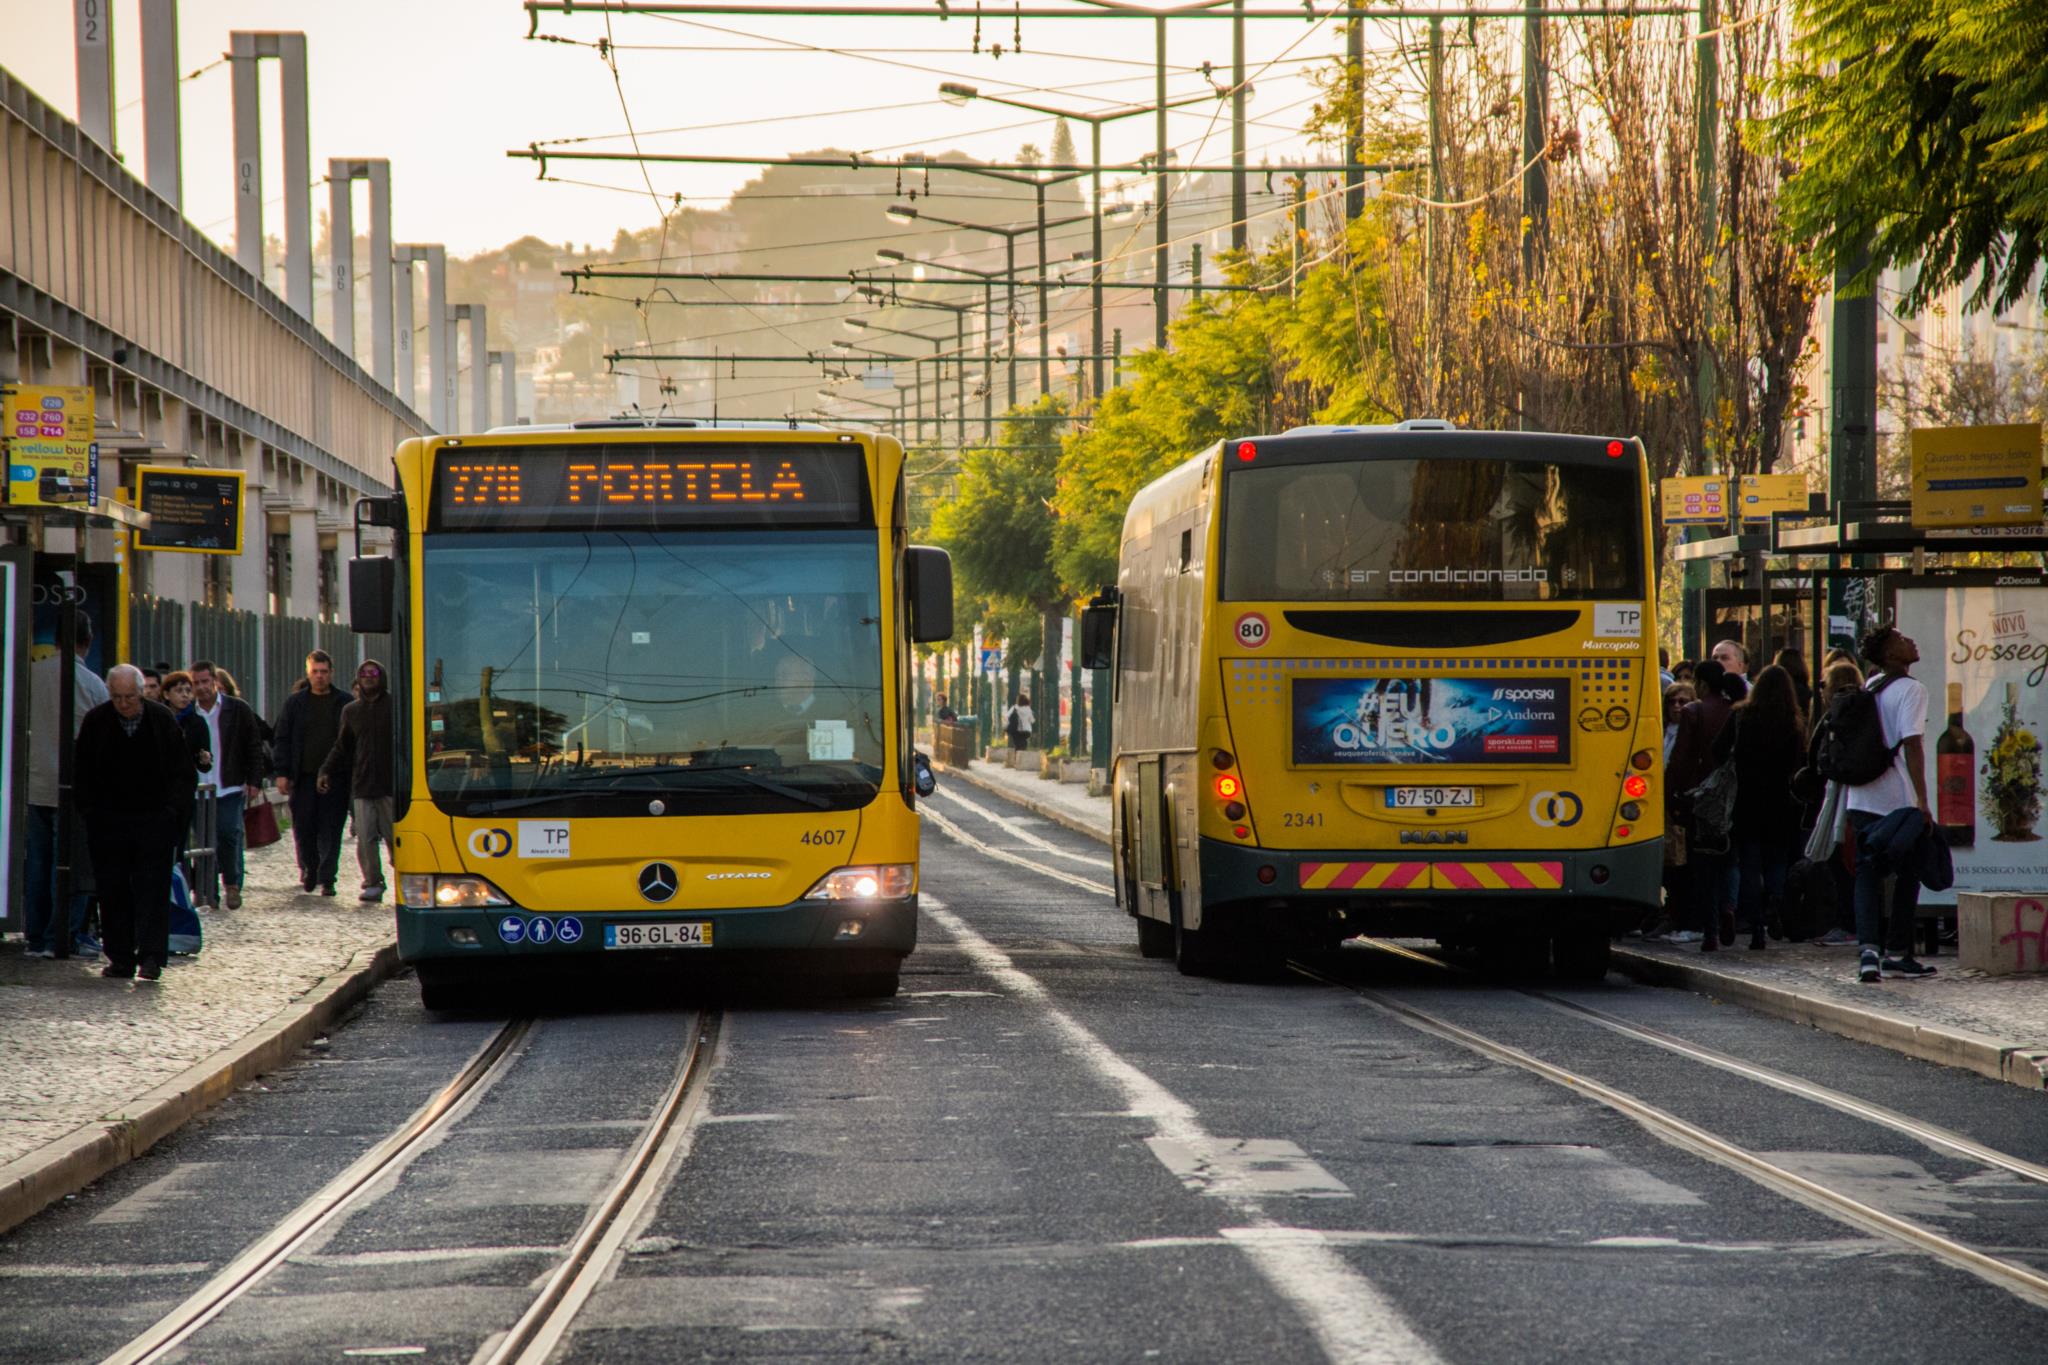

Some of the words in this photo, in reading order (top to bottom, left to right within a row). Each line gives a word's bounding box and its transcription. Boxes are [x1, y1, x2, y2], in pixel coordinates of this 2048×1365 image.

[241, 162, 251, 194] 04
[19, 413, 36, 421] 732
[44, 413, 61, 421] 760
[43, 427, 61, 435] 714
[22, 469, 33, 477] 18
[569, 463, 803, 501] PORTELA
[1350, 569, 1380, 583] ar
[1389, 565, 1548, 583] condicionado
[1995, 576, 2041, 586] JCDecaux
[1617, 610, 1640, 625] TP
[1992, 613, 2026, 635] NOVO
[1241, 623, 1264, 637] 80
[1582, 640, 1640, 652] Marcopolo
[1951, 629, 2048, 688] Sosseg
[1505, 688, 1555, 702] sporski
[1356, 692, 1421, 721] #EU
[1504, 708, 1555, 721] Andorra
[1332, 722, 1456, 750] QUERO
[1487, 737, 1533, 746] sporski.com
[1284, 813, 1324, 828] 2341
[543, 828, 569, 845] TP
[801, 829, 846, 846] 4607
[1400, 830, 1469, 844] MAN
[706, 872, 772, 880] CITARO
[1971, 865, 2016, 875] SOSSEGO
[2017, 865, 2032, 874] NA
